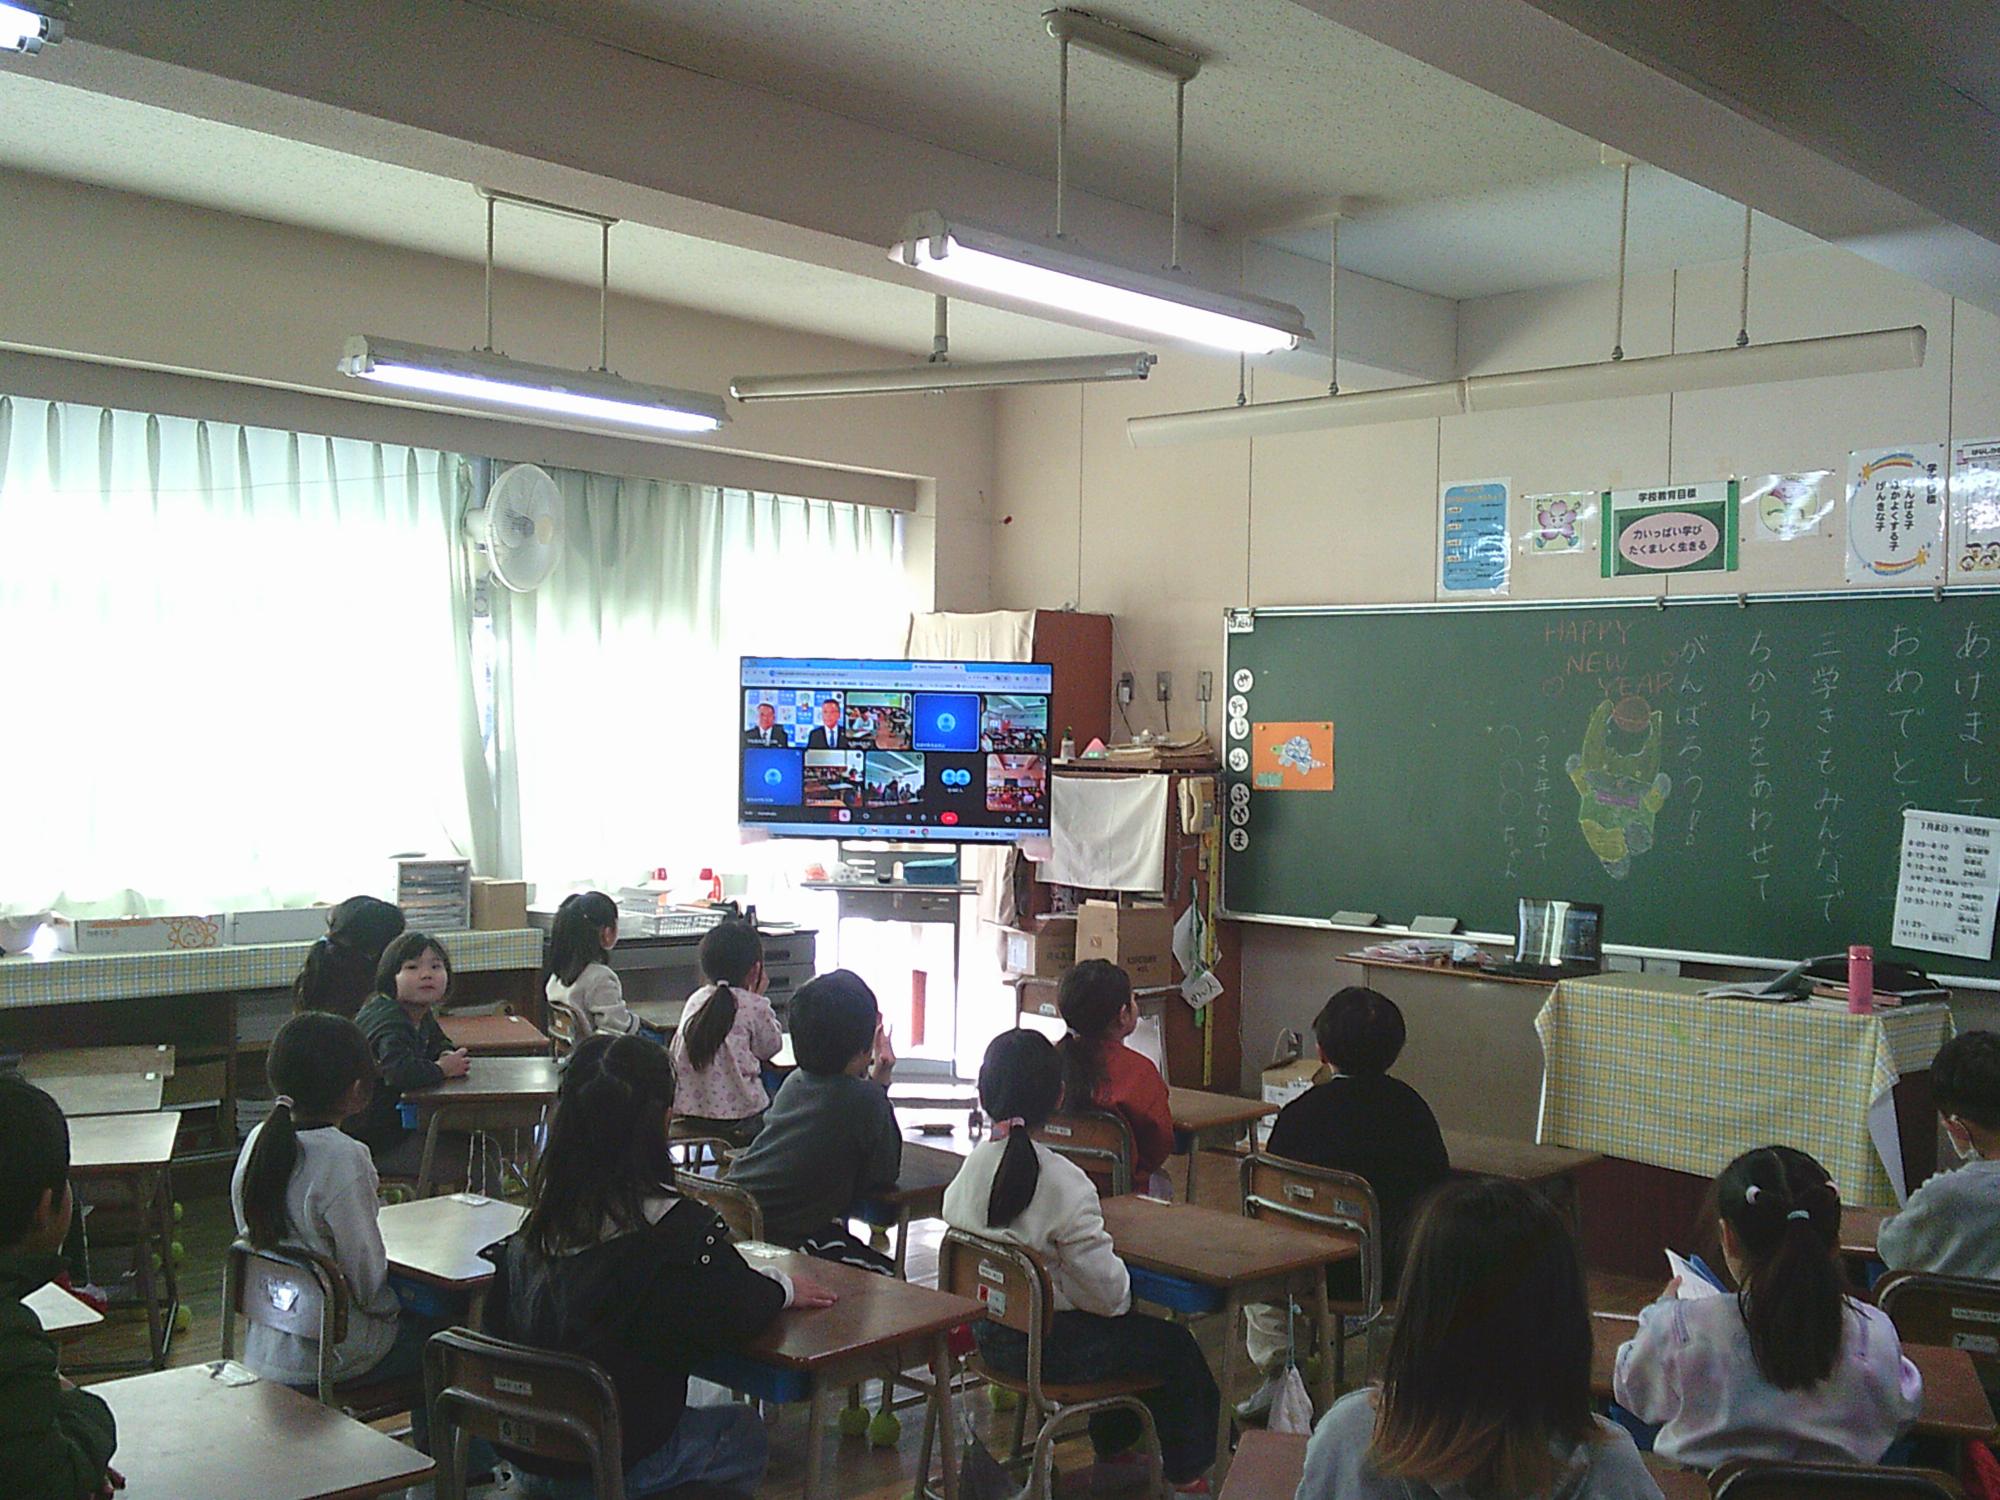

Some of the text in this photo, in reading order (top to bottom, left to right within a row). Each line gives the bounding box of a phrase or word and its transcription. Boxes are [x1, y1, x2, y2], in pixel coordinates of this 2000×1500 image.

[1638, 488, 1697, 503] 学校教育目標
[1875, 480, 1887, 532] げんきな子
[1904, 481, 1915, 530] んばる子
[1633, 525, 1704, 540] 力いっぱい学び
[1629, 541, 1708, 555] たくましく生きる
[1545, 619, 1634, 645] HAPPY
[1566, 652, 1629, 676] NEW
[1597, 671, 1680, 697] YEAR
[1747, 629, 1777, 901] ちからをあわせて
